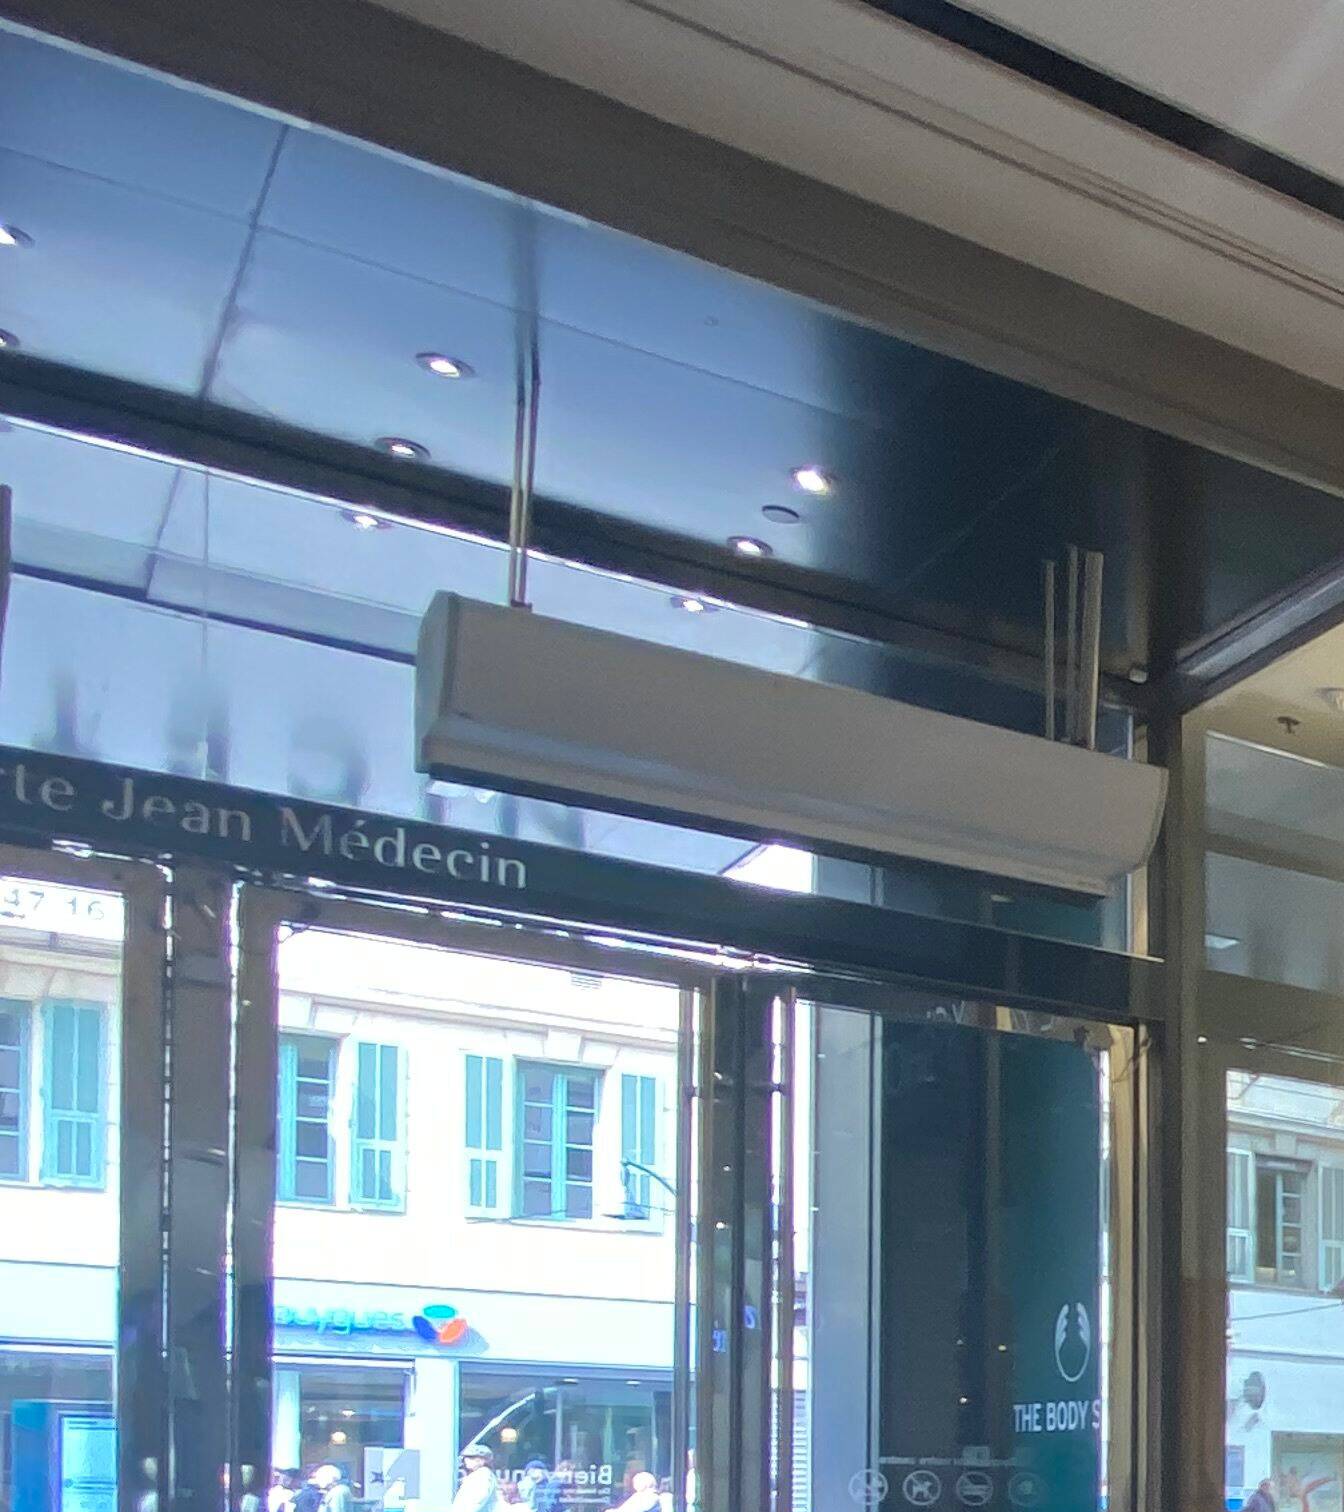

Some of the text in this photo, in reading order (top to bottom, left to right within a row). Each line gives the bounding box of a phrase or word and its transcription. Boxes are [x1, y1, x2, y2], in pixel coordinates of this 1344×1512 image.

[101, 775, 253, 843] Jean
[281, 806, 528, 890] Médecin
[1012, 1403, 1042, 1433] THE
[1046, 1400, 1090, 1431] BODY
